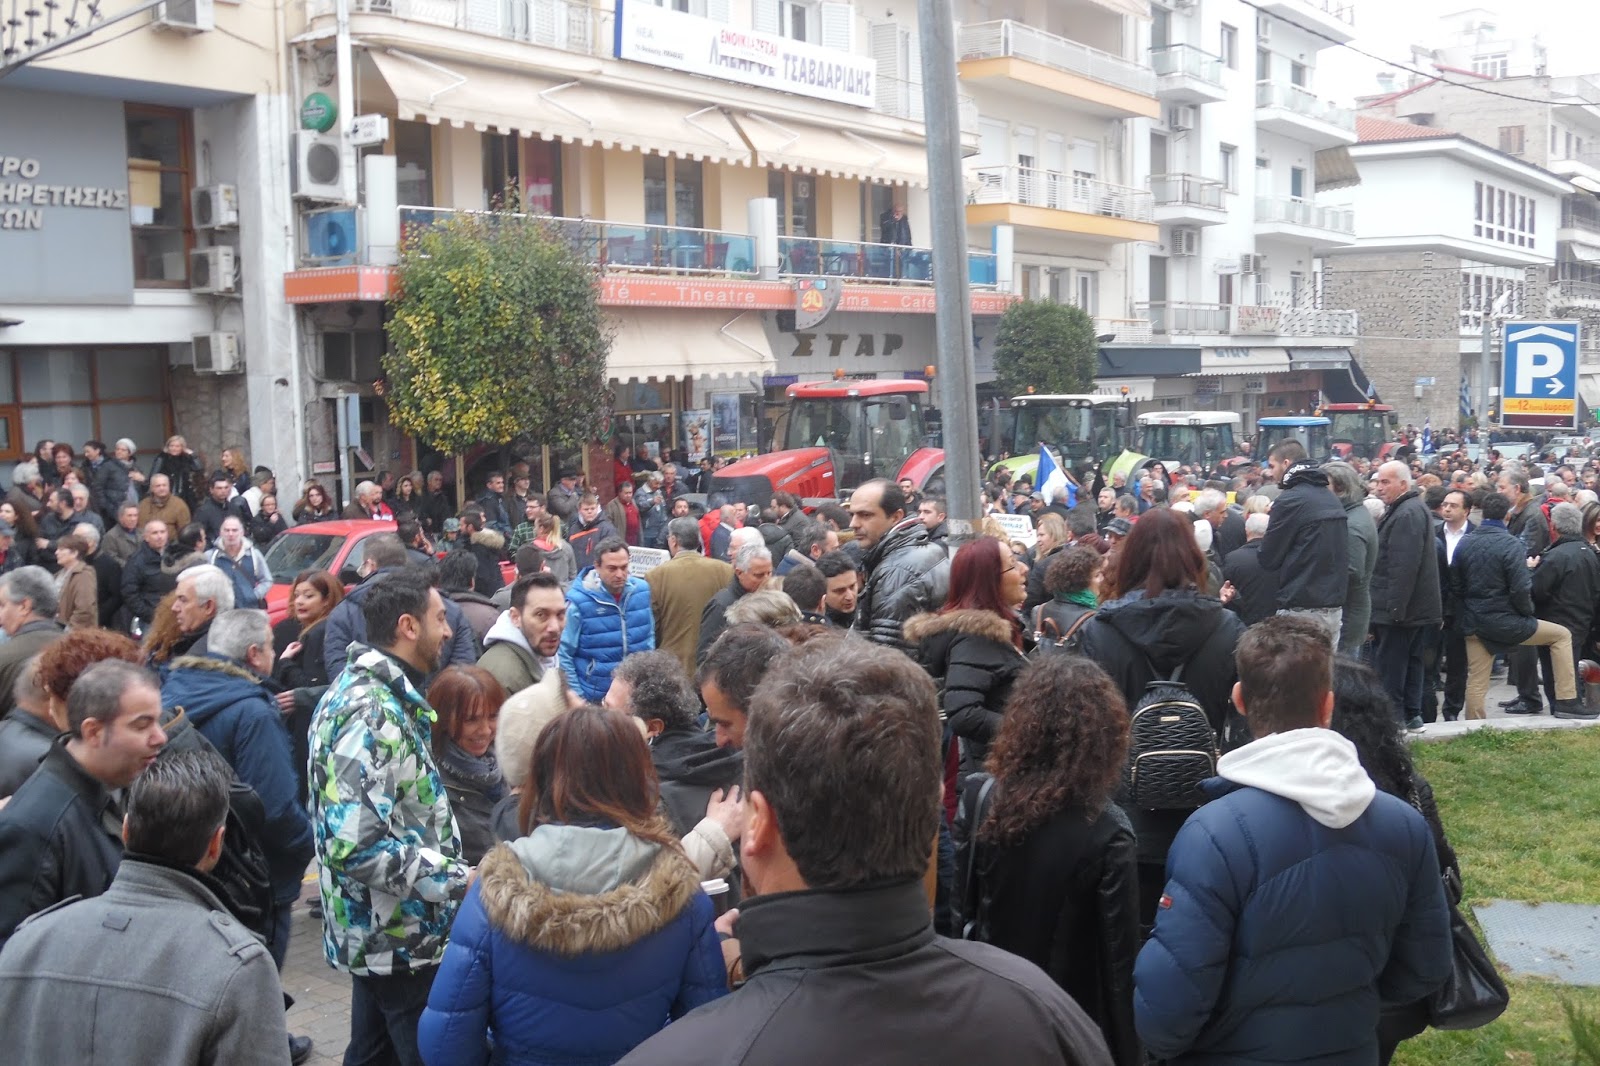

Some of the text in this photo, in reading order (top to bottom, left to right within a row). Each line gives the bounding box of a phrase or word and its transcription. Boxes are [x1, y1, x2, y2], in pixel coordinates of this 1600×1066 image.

[782, 52, 871, 97] ΤΣΑΒΔΑΡΙΔΗΣ
[0, 157, 40, 178] ΡΟ
[676, 286, 756, 303] Theatre
[900, 295, 936, 308] Café
[790, 332, 905, 357] ΣΤΑΡ
[1515, 342, 1565, 395] P
